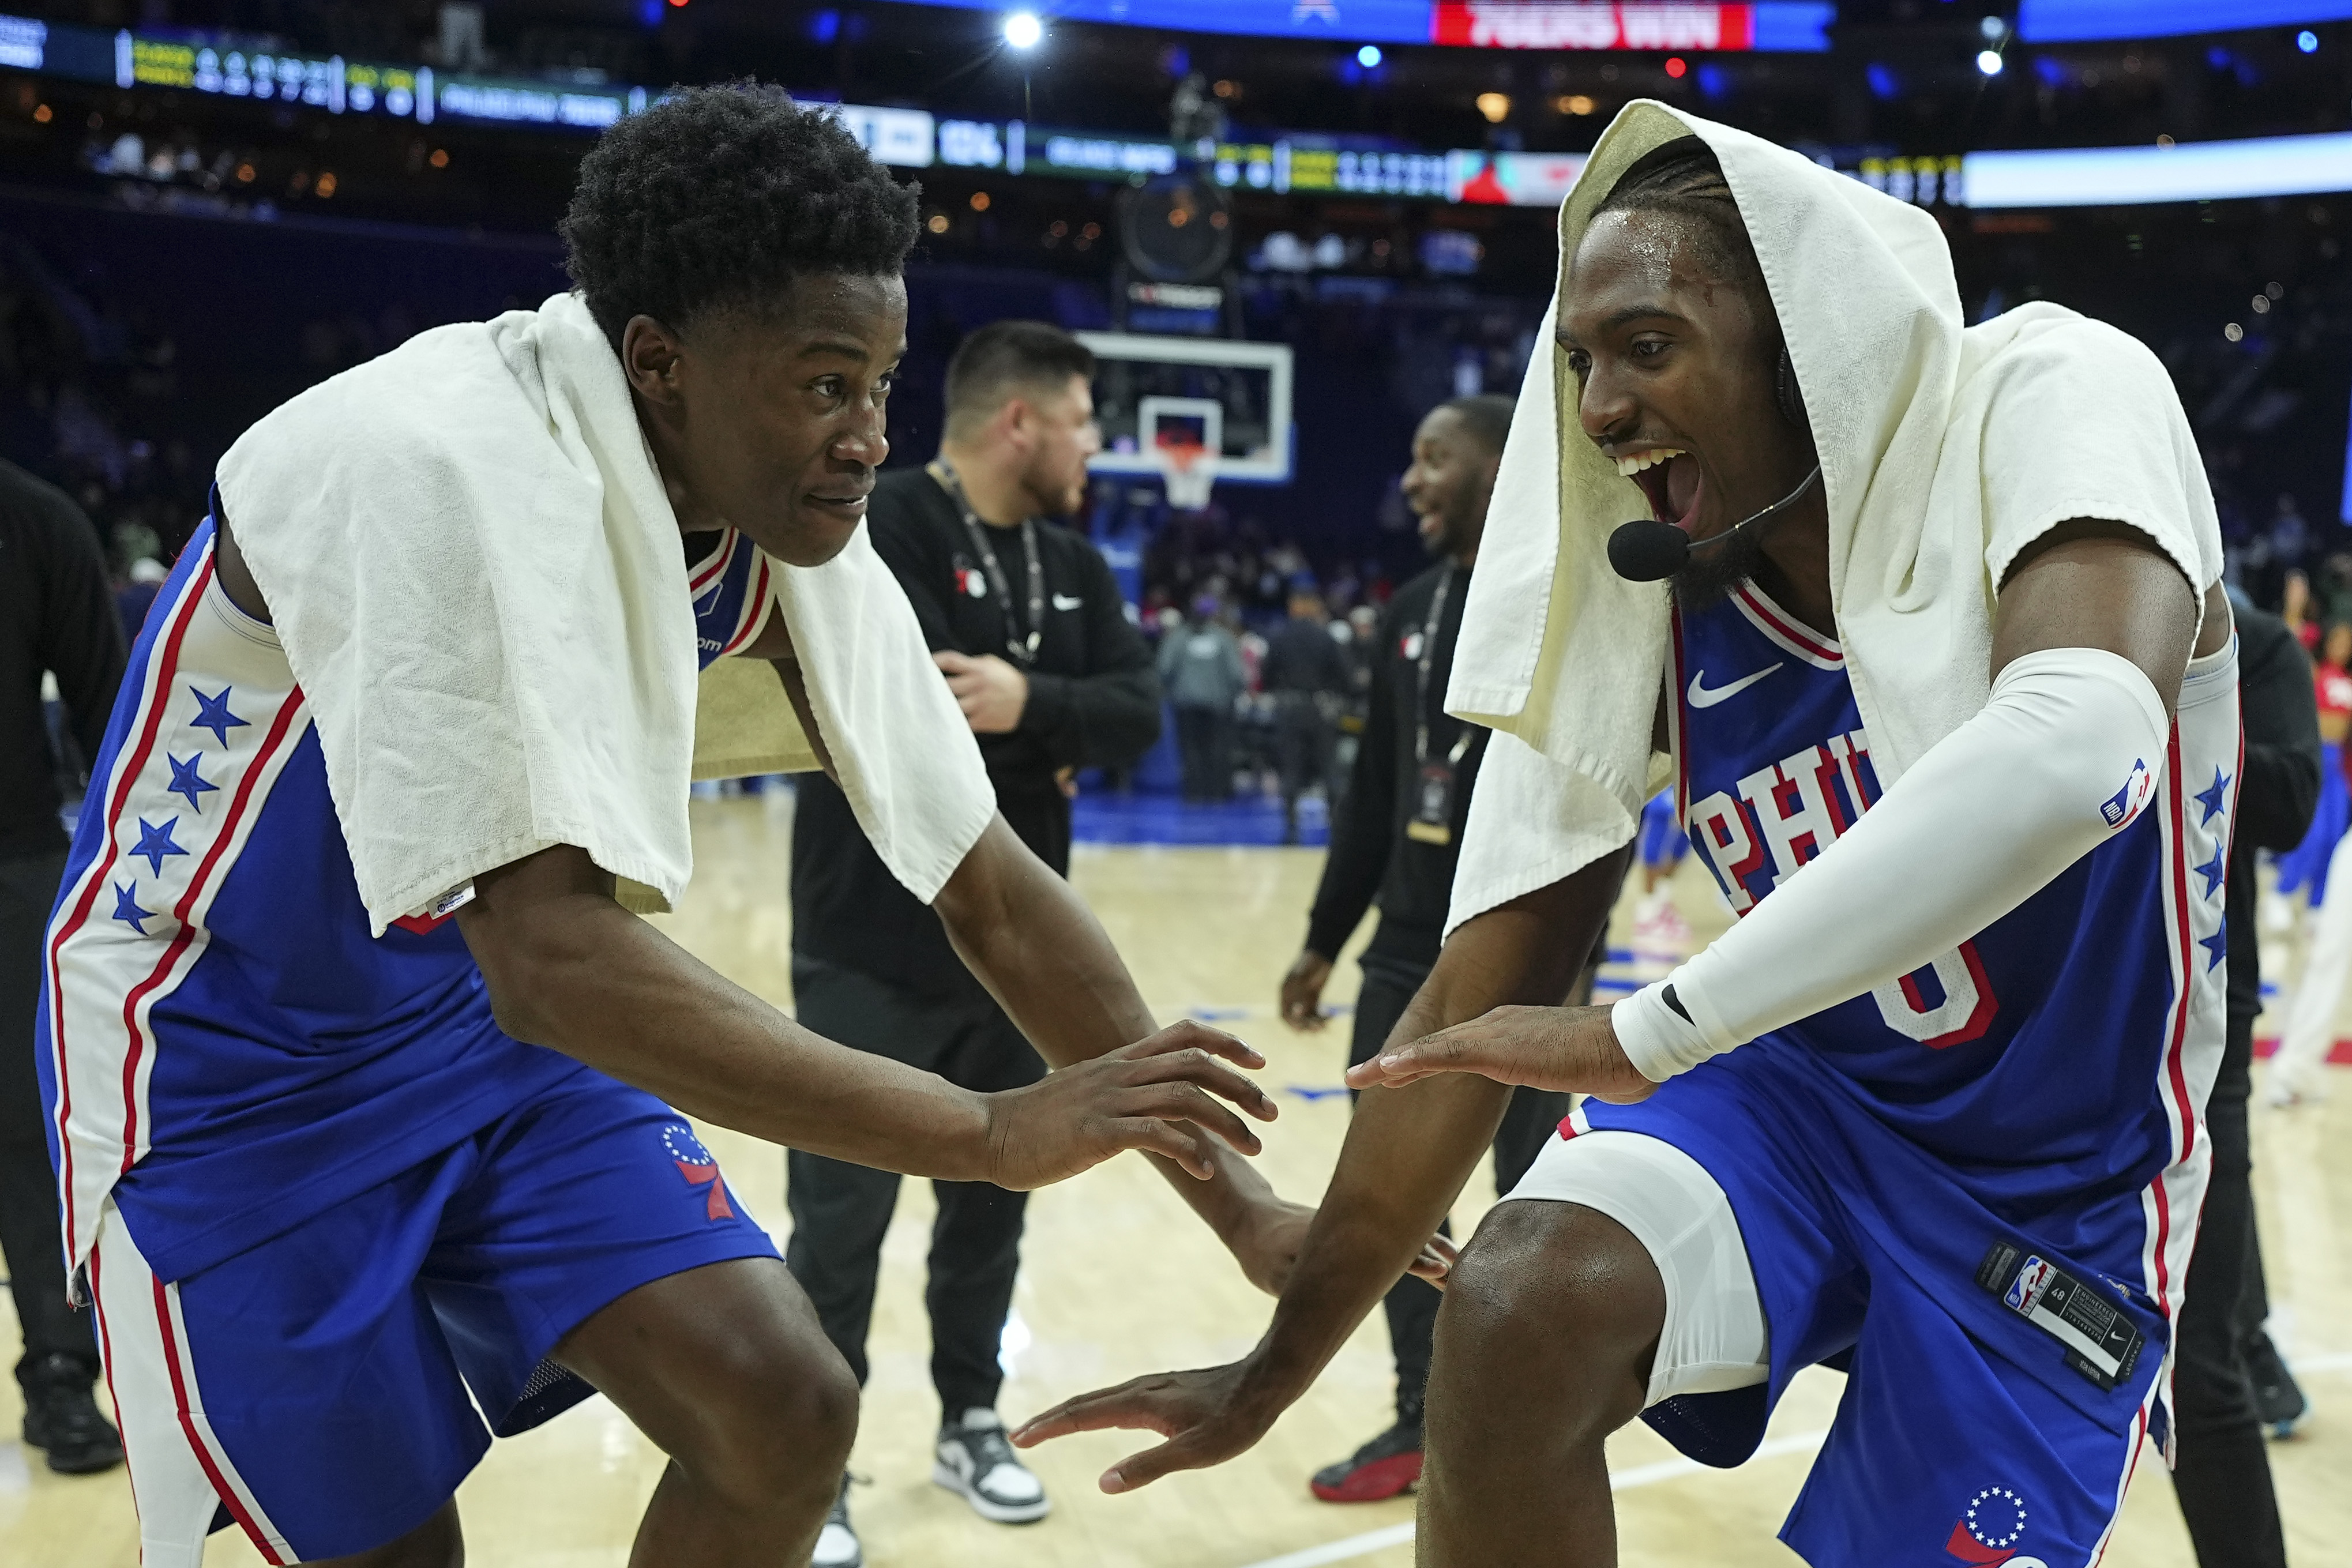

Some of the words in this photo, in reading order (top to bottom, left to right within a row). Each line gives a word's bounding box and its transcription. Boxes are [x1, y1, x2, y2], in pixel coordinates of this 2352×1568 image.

[1619, 2, 1721, 50] WIN
[1690, 728, 1869, 917] PHI
[2103, 801, 2123, 822] NBA
[2051, 1287, 2065, 1301] 48
